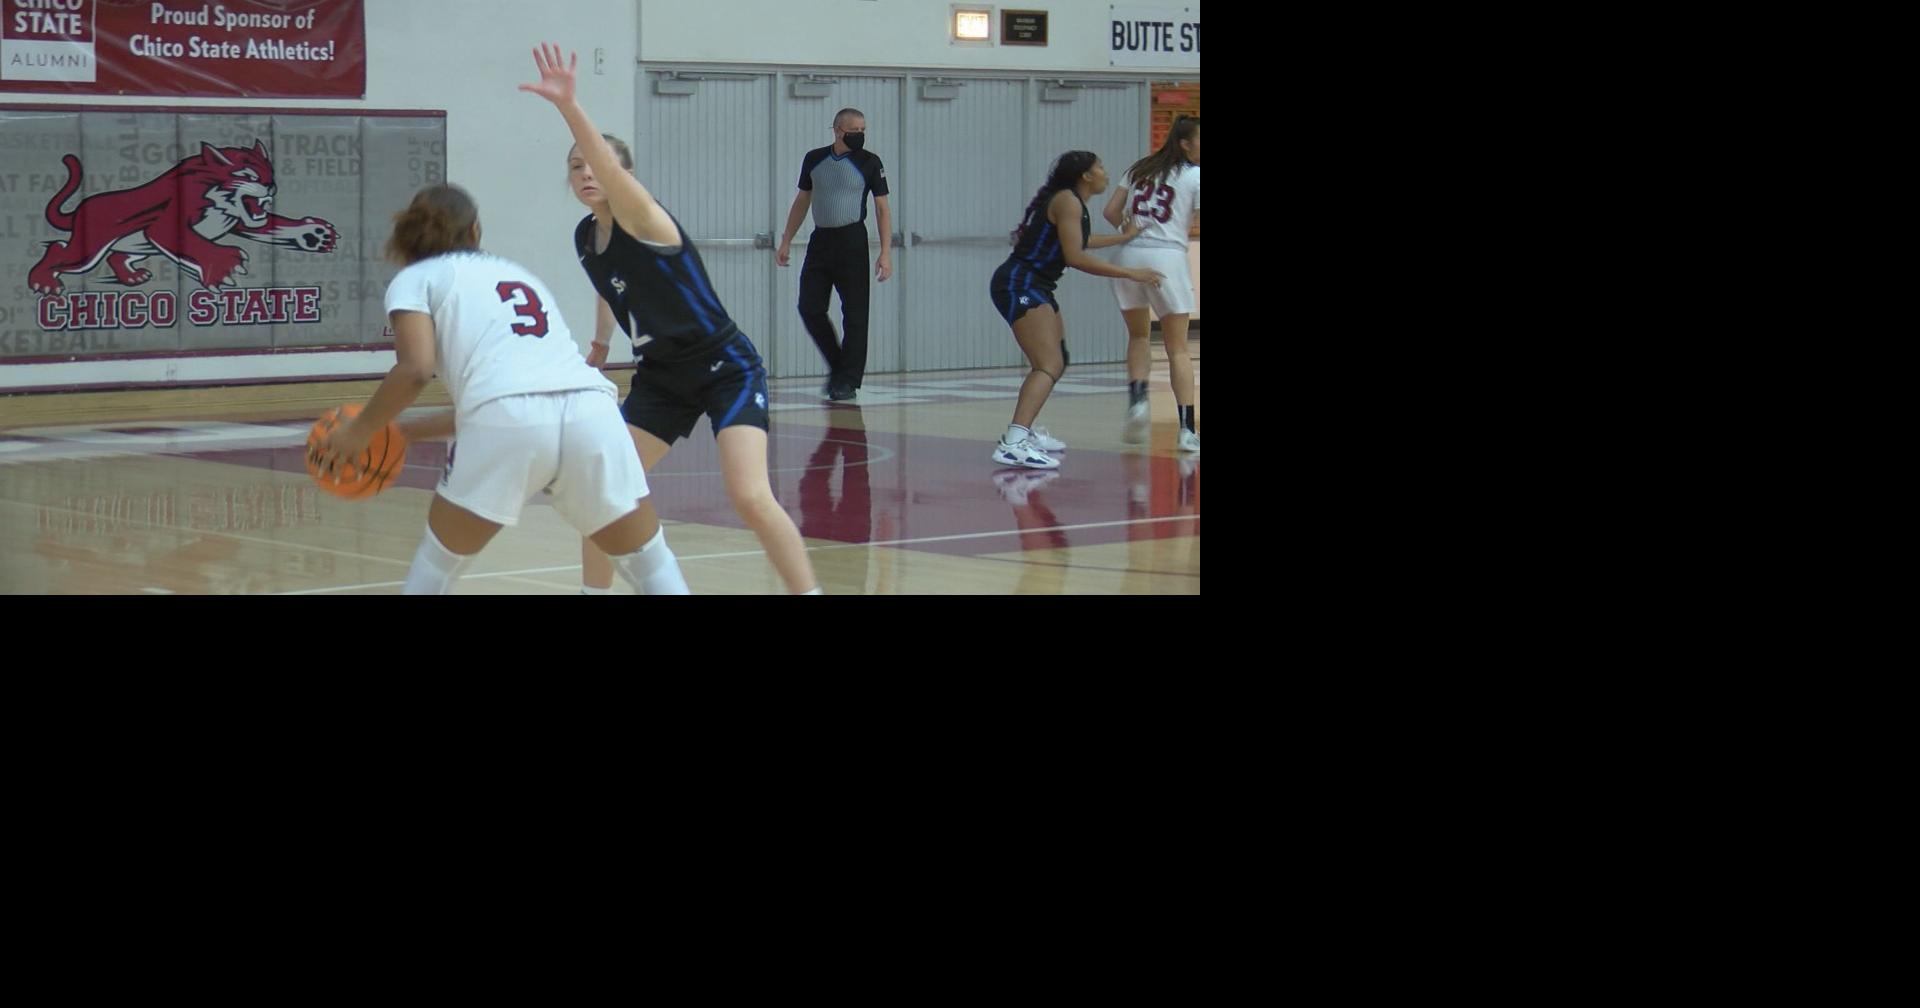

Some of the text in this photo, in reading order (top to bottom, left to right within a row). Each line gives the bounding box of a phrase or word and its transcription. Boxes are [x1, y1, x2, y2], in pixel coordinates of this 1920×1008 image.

[14, 11, 83, 35] STATE
[151, 3, 315, 32] Proud Sponsor of
[129, 35, 335, 61] Chico State Athletics!
[1112, 21, 1175, 52] BUTTE
[10, 53, 88, 68] ALUMNI
[279, 134, 363, 156] TRACK
[305, 158, 362, 177] FIELD
[28, 173, 116, 192] FALY
[1132, 180, 1175, 224] 23
[37, 291, 179, 332] CHICO
[187, 286, 322, 328] STATE
[495, 280, 550, 338] 3
